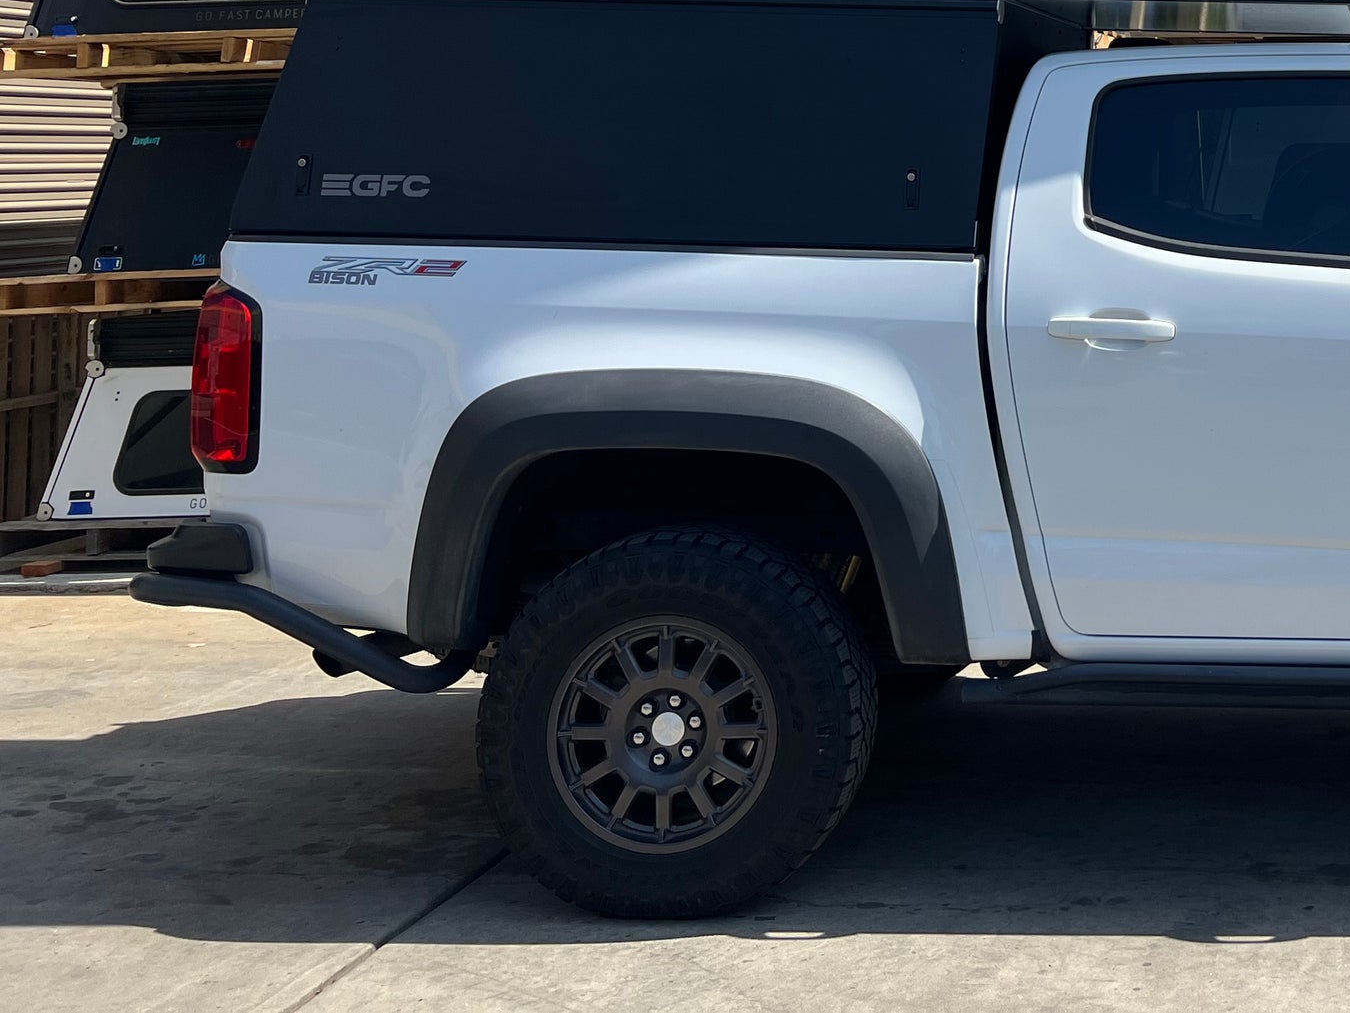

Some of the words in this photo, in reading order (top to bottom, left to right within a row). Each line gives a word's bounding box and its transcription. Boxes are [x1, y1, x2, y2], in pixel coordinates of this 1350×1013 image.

[195, 11, 213, 22] GO
[218, 9, 251, 21] FAST
[311, 255, 468, 278] ZR2
[308, 271, 378, 286] BISON
[190, 498, 207, 509] GO
